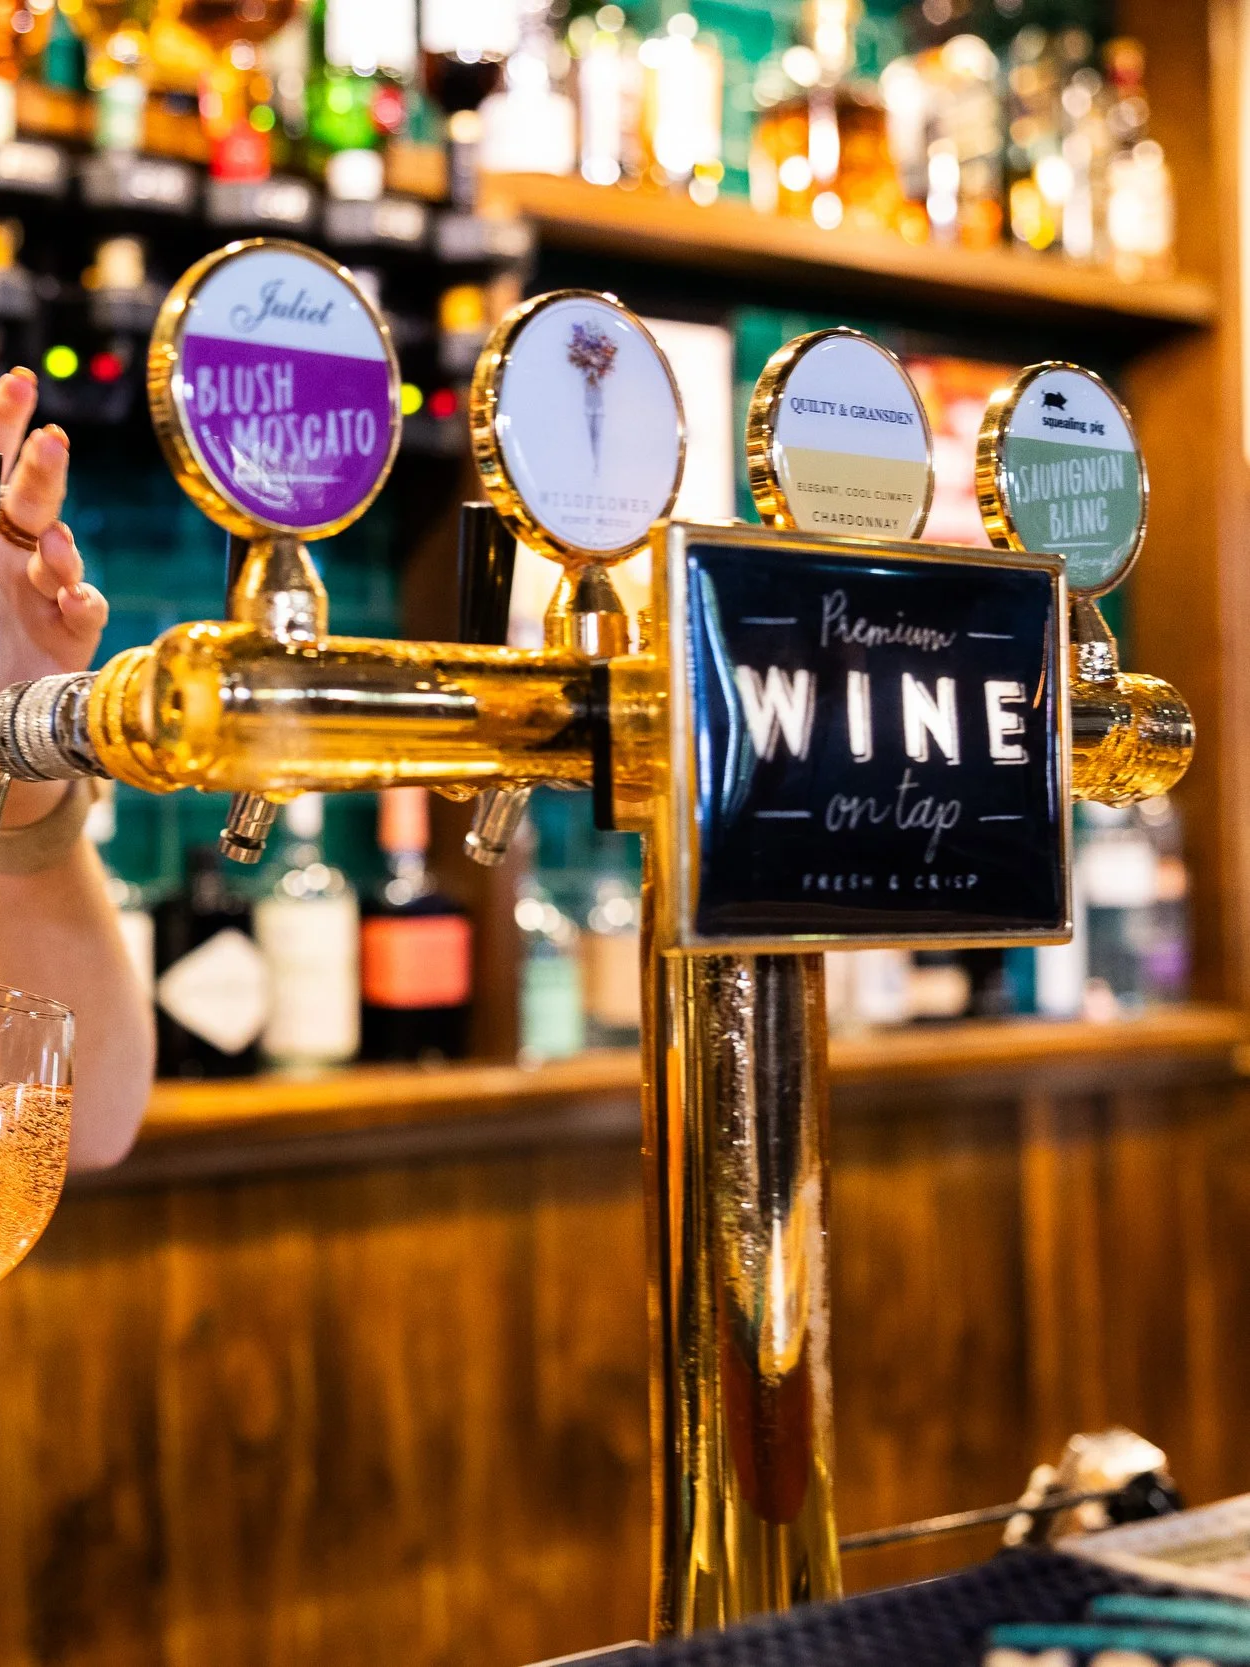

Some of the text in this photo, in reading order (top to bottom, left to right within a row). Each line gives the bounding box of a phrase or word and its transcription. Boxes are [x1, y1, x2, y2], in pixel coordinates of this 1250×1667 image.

[229, 278, 333, 333] Juliet
[196, 361, 294, 418] BLUSH
[790, 397, 914, 425] QUILTY & GRANSDEN
[231, 408, 377, 466] MOSCATO
[1042, 416, 1105, 436] squealing pig
[845, 487, 872, 499] COOL
[874, 490, 913, 504] CLIMATE
[1018, 454, 1124, 503] SAUVIGNON
[539, 490, 652, 514] WILDFLOWER
[812, 511, 899, 529] CHARDONNAY
[1050, 497, 1109, 541] BLANC
[820, 588, 957, 651] Premium
[735, 664, 1030, 766] WINE
[825, 767, 961, 863] on tap
[802, 873, 874, 892] FRESH
[913, 873, 978, 890] CRISP
